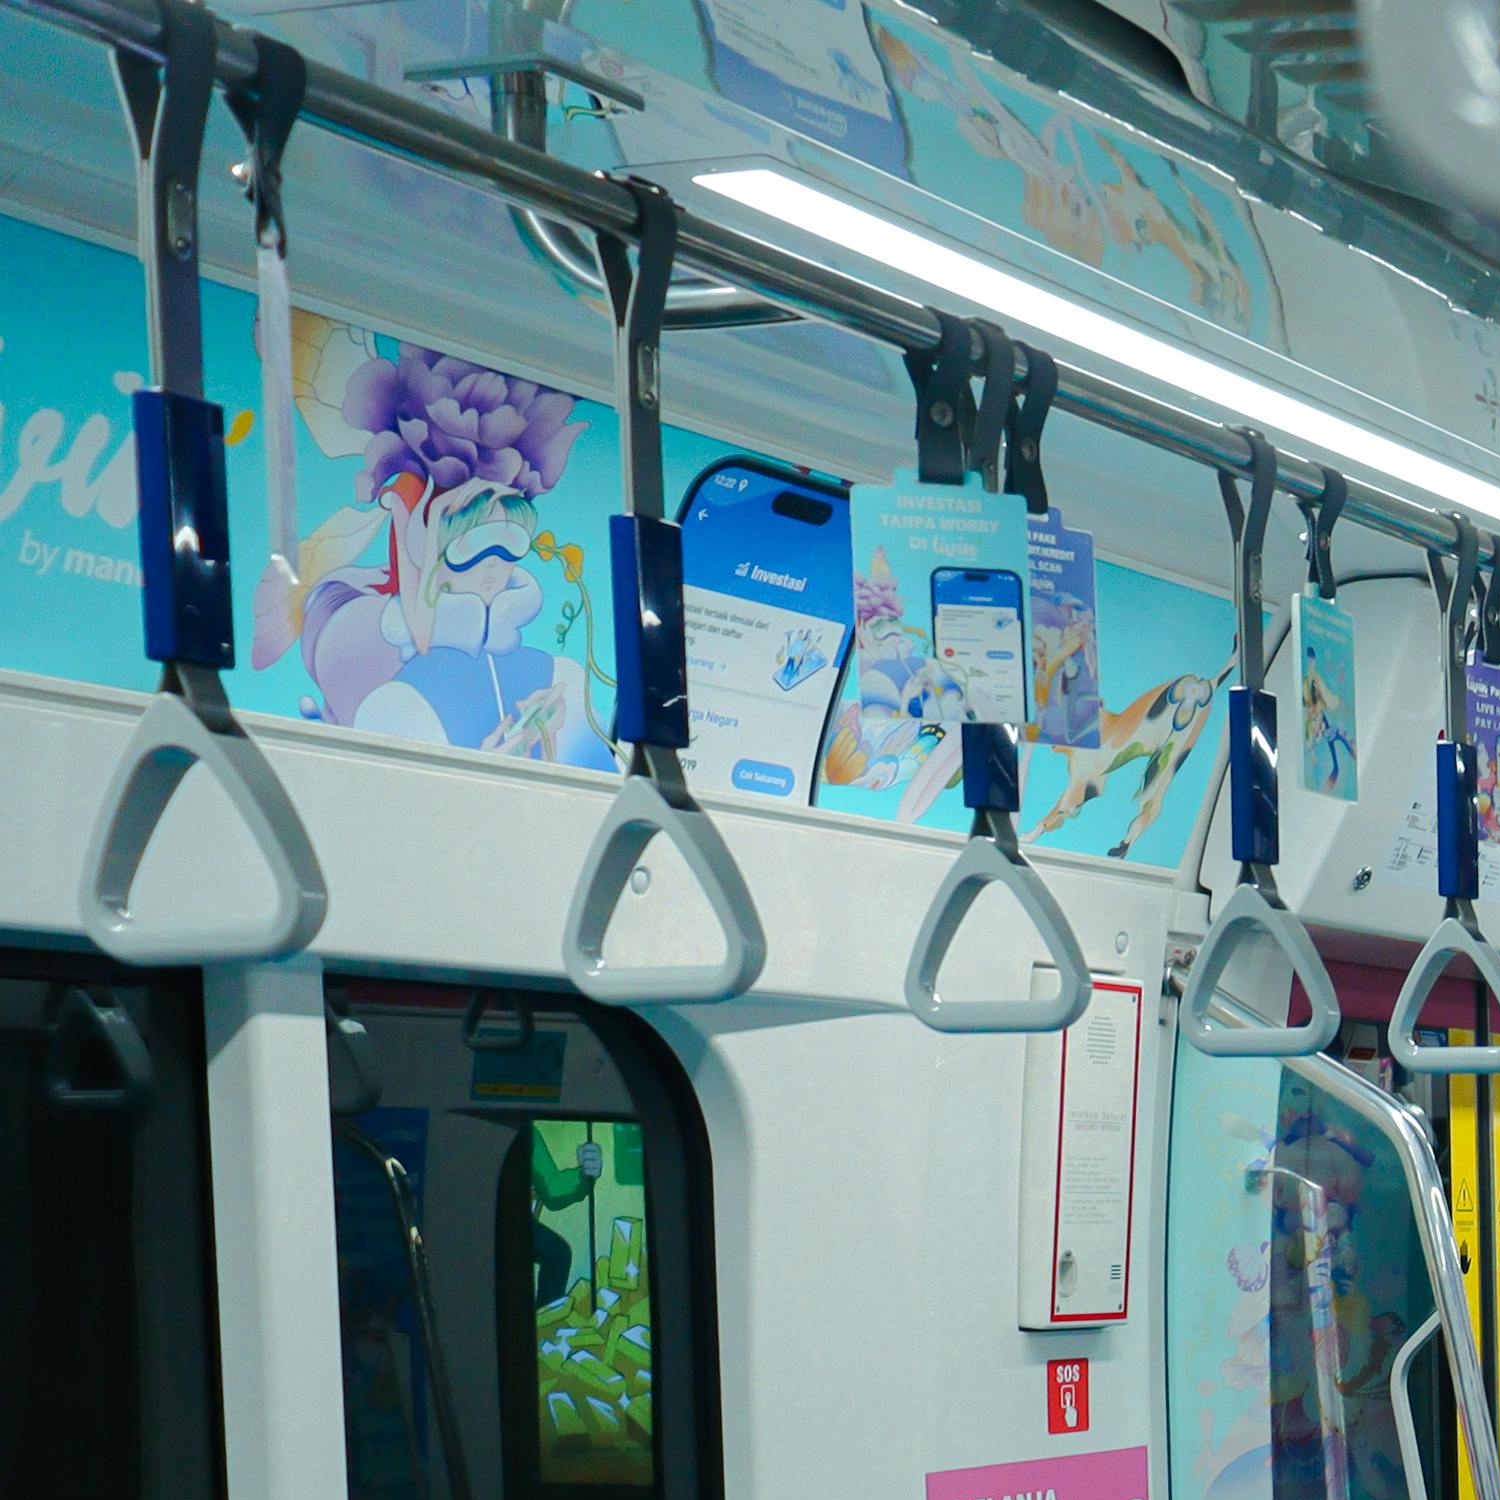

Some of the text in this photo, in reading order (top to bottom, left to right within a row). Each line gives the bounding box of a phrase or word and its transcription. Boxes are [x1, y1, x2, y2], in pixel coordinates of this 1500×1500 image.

[896, 495, 982, 513] INVESTASI
[880, 514, 1000, 533] TANPA WORRY
[18, 528, 60, 576] by
[751, 565, 807, 592] Investasi
[1476, 702, 1495, 716] LIVE
[705, 710, 739, 728] Negara
[1475, 717, 1491, 730] PAY
[1056, 1364, 1080, 1383] SOS
